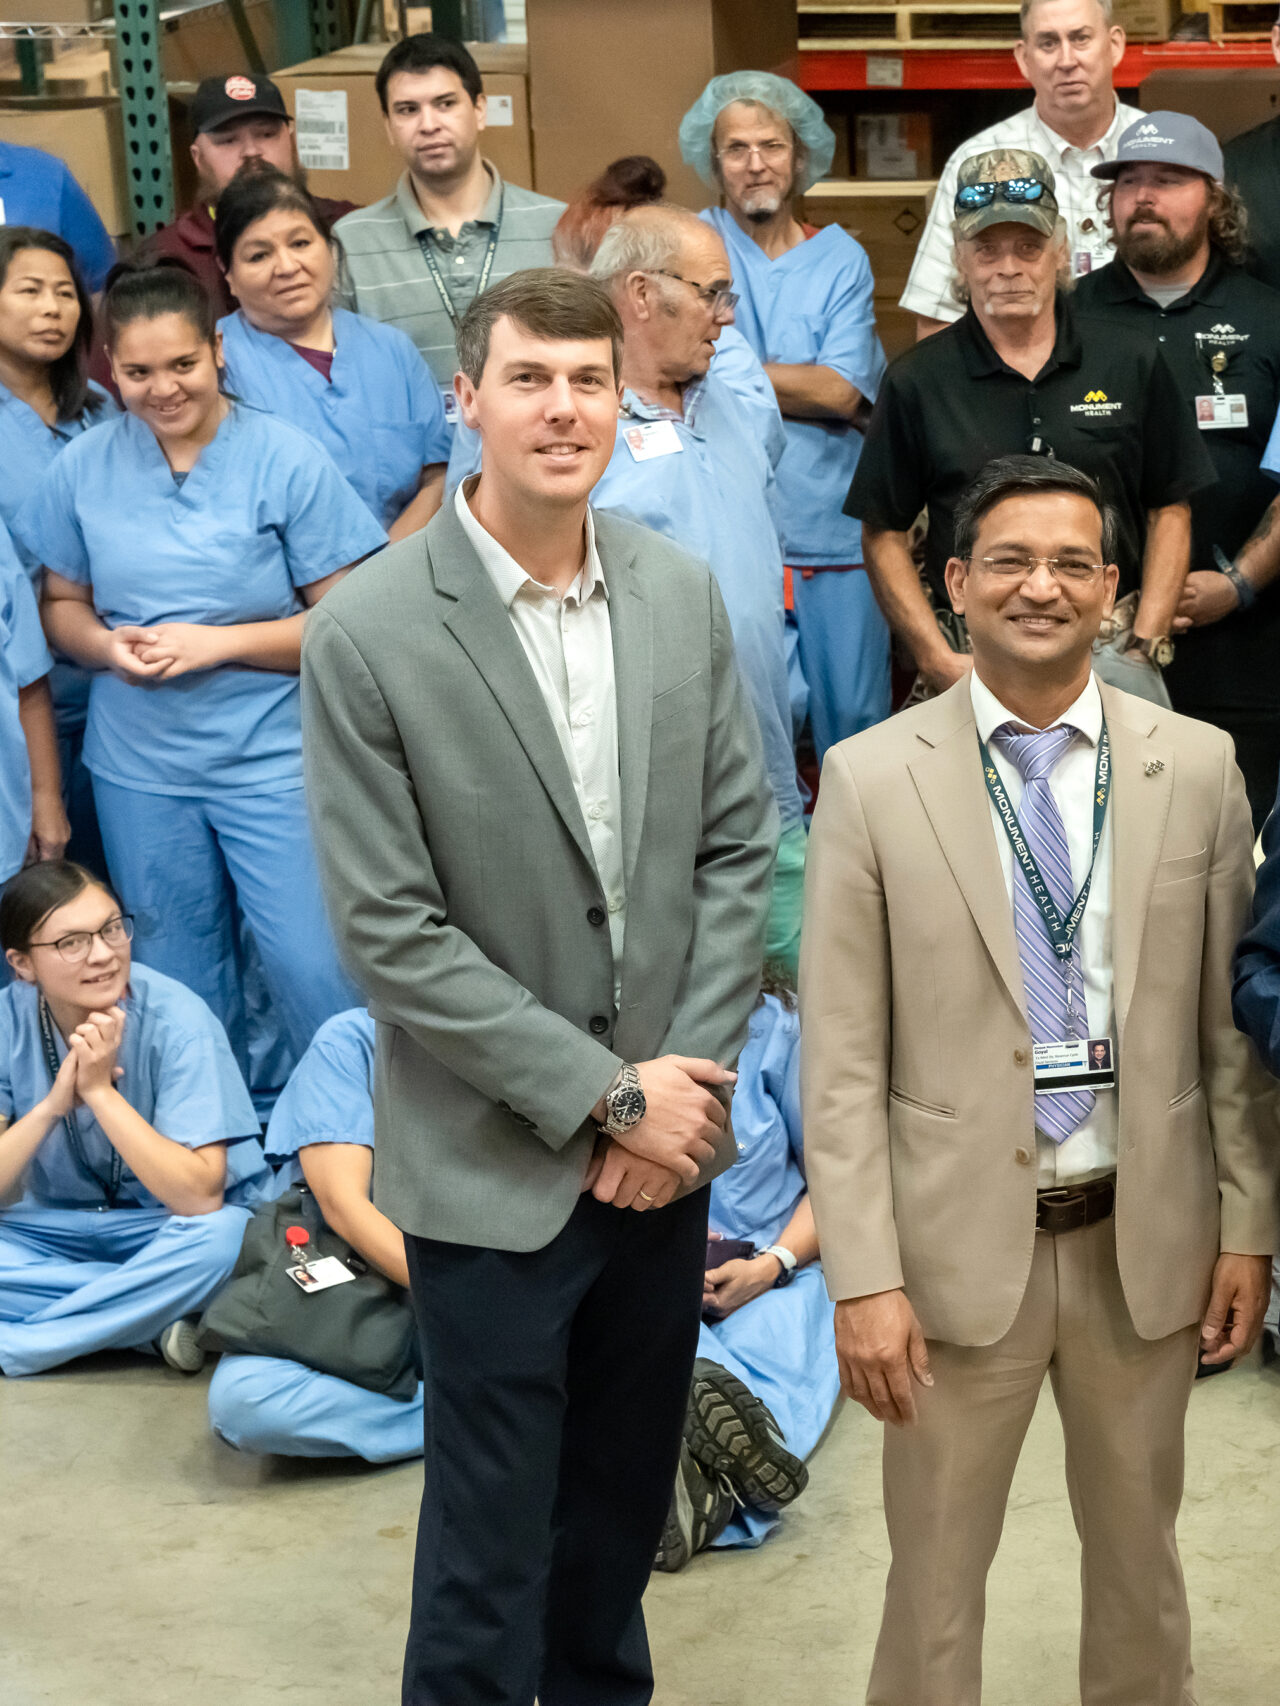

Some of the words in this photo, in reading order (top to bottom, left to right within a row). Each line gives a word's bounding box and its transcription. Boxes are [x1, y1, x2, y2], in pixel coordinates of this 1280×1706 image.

[1069, 402, 1122, 412] MONUMENT
[992, 785, 1035, 872] MONUMENT
[1030, 874, 1061, 932] HEALTH
